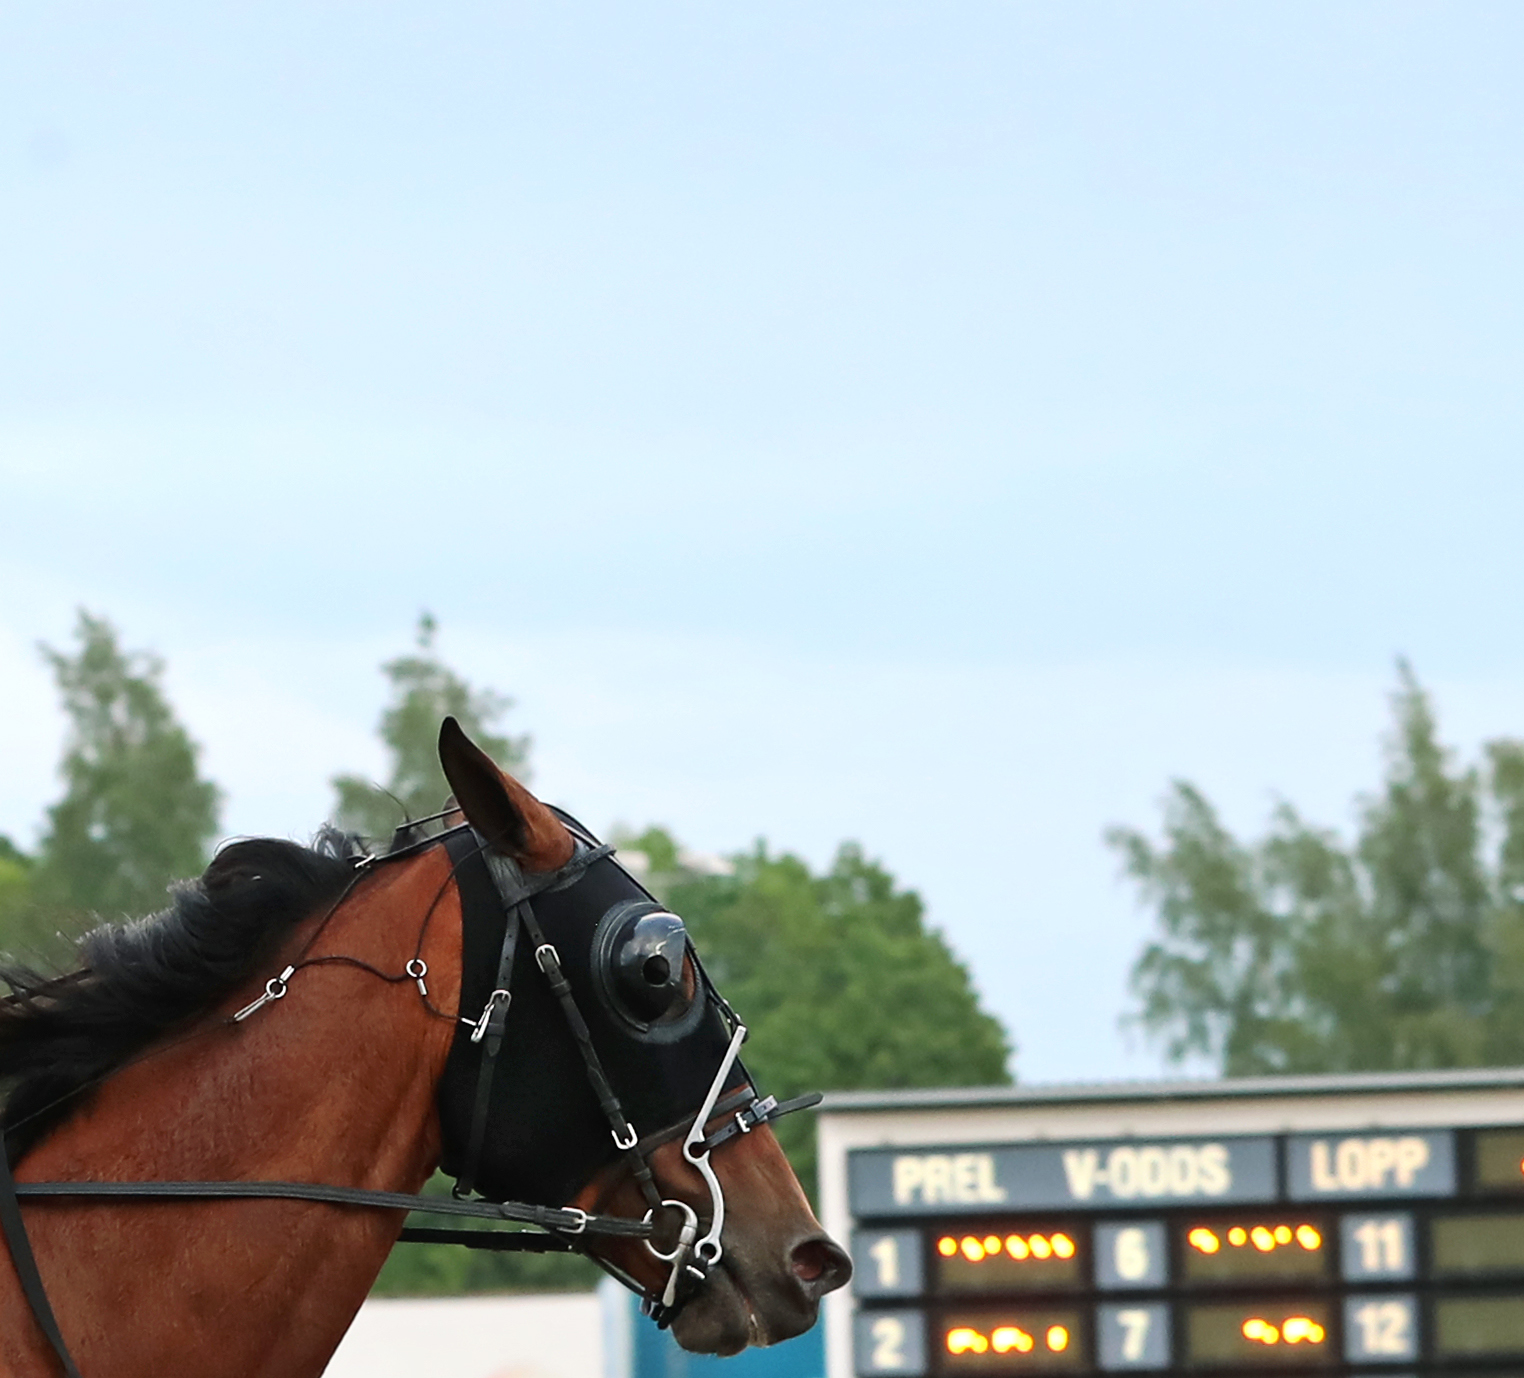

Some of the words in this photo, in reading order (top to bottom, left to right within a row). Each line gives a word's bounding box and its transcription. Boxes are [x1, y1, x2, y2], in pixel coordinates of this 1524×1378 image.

[892, 1154, 1007, 1205] PREL
[1310, 1136, 1430, 1191] LOPP
[870, 1236, 899, 1288] 1
[1114, 1227, 1147, 1280] 6
[1354, 1220, 1402, 1272] 11
[871, 1317, 905, 1369] 2
[1115, 1309, 1149, 1361] 7
[1355, 1302, 1409, 1356] 12
